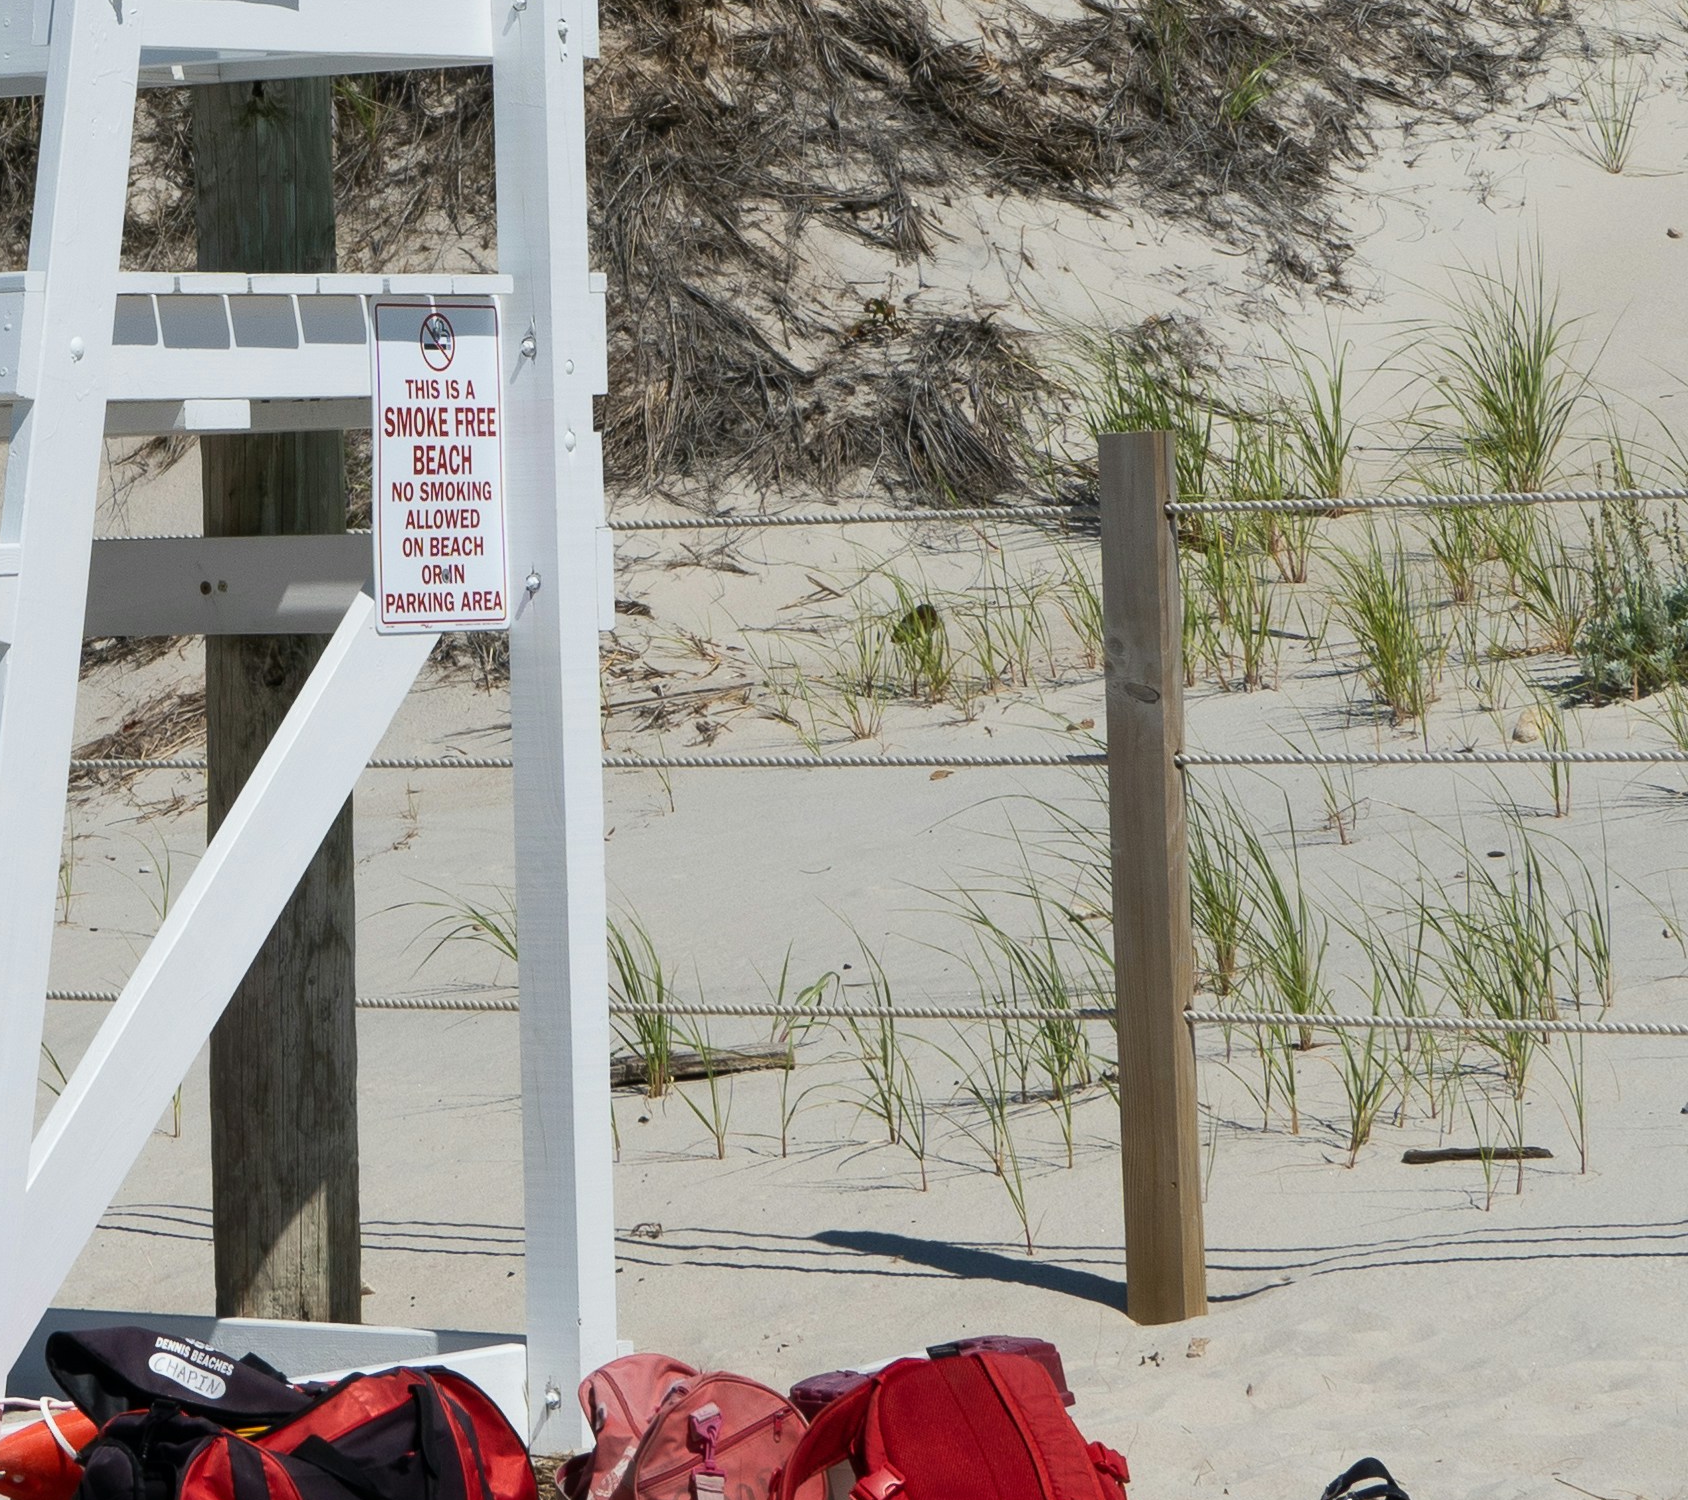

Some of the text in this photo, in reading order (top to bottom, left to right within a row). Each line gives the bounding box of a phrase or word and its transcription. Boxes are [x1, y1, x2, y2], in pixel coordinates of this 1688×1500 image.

[405, 379, 476, 400] THIS IS A
[384, 406, 497, 438] SMOKE FREE
[413, 445, 472, 475] BEACH
[392, 481, 492, 502] NO SMOKING
[405, 509, 480, 529] ALLOWED
[402, 536, 484, 557] ON BEACH
[421, 564, 465, 585] OR IN
[385, 590, 503, 614] PARKING AREA
[155, 1336, 191, 1358] DENNIS
[190, 1349, 234, 1376] BEACHES
[153, 1357, 221, 1395] CHAPIN
